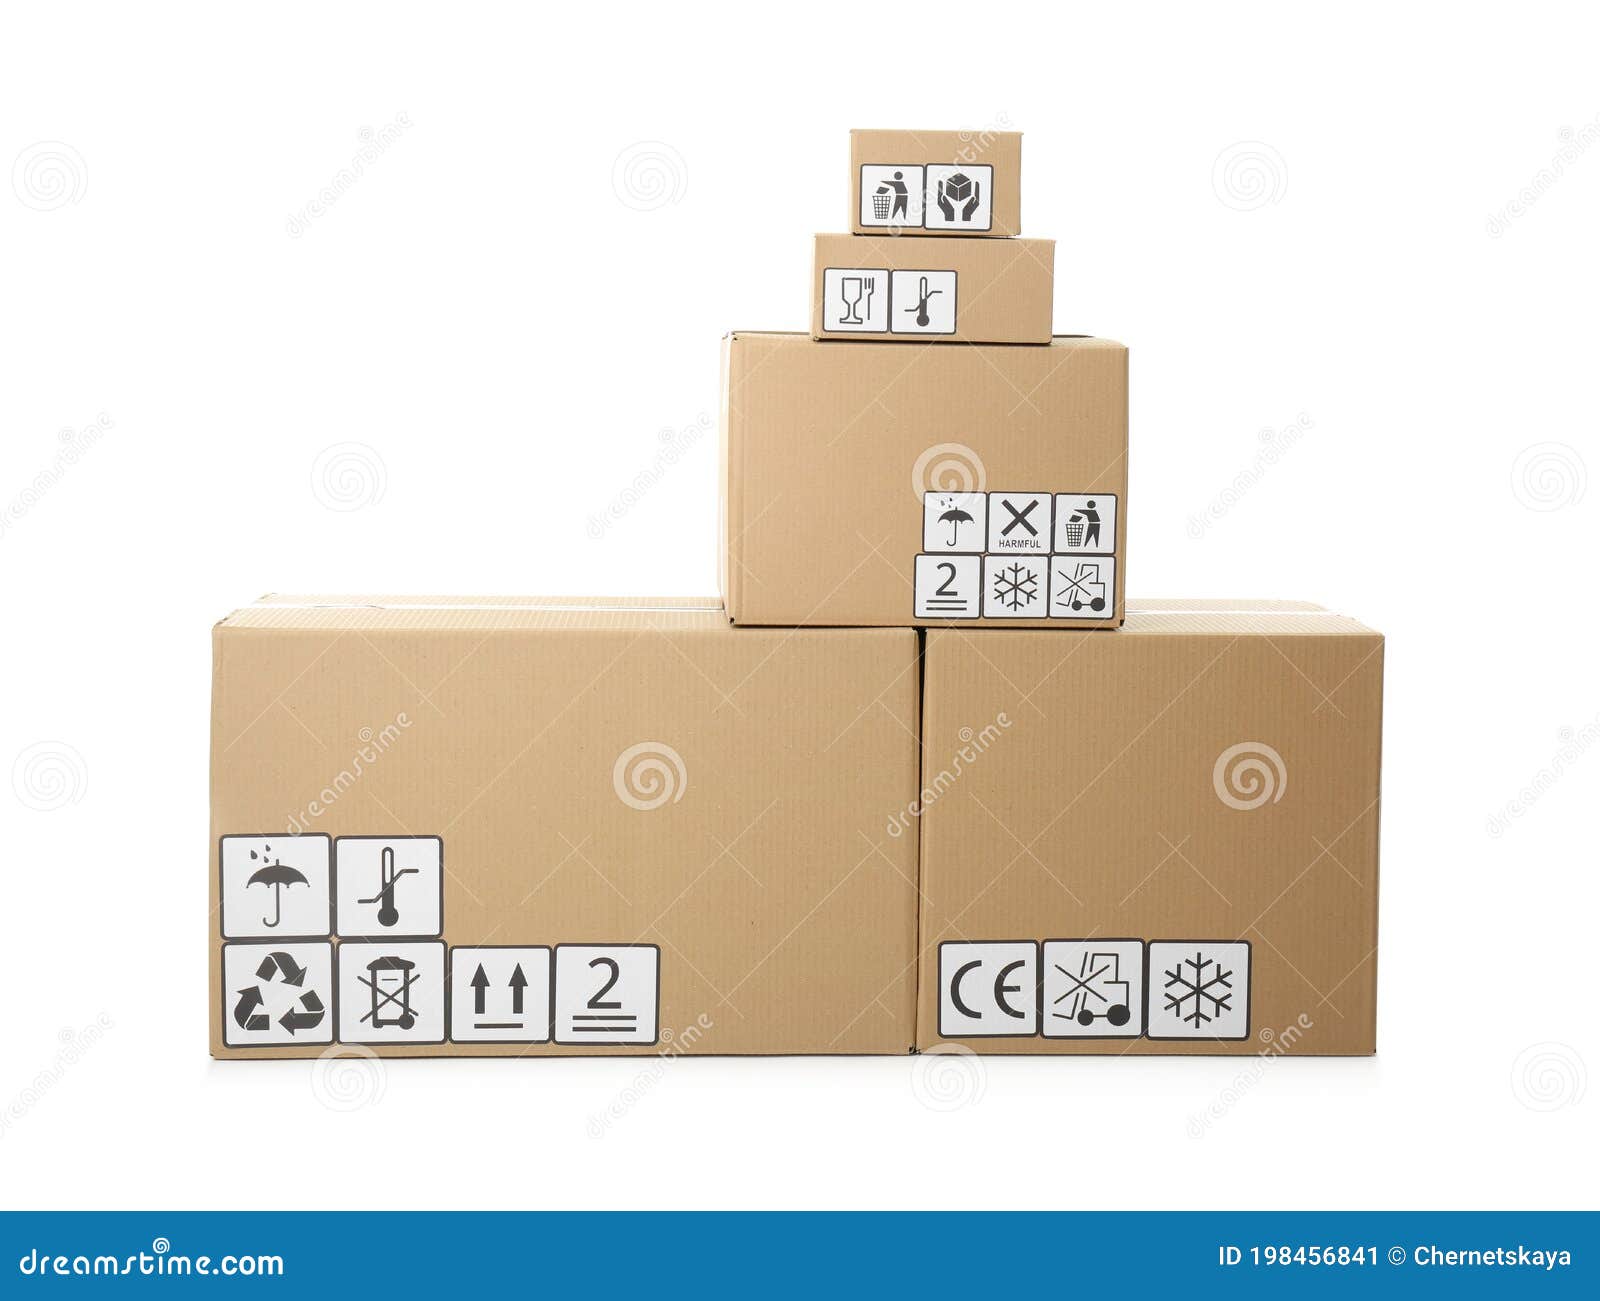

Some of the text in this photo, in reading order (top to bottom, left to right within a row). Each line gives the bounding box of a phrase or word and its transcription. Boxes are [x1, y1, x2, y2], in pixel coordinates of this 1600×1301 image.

[998, 539, 1041, 549] HARMFUL
[935, 562, 958, 597] 2
[587, 957, 622, 1010] 2
[950, 959, 1026, 1019] CE
